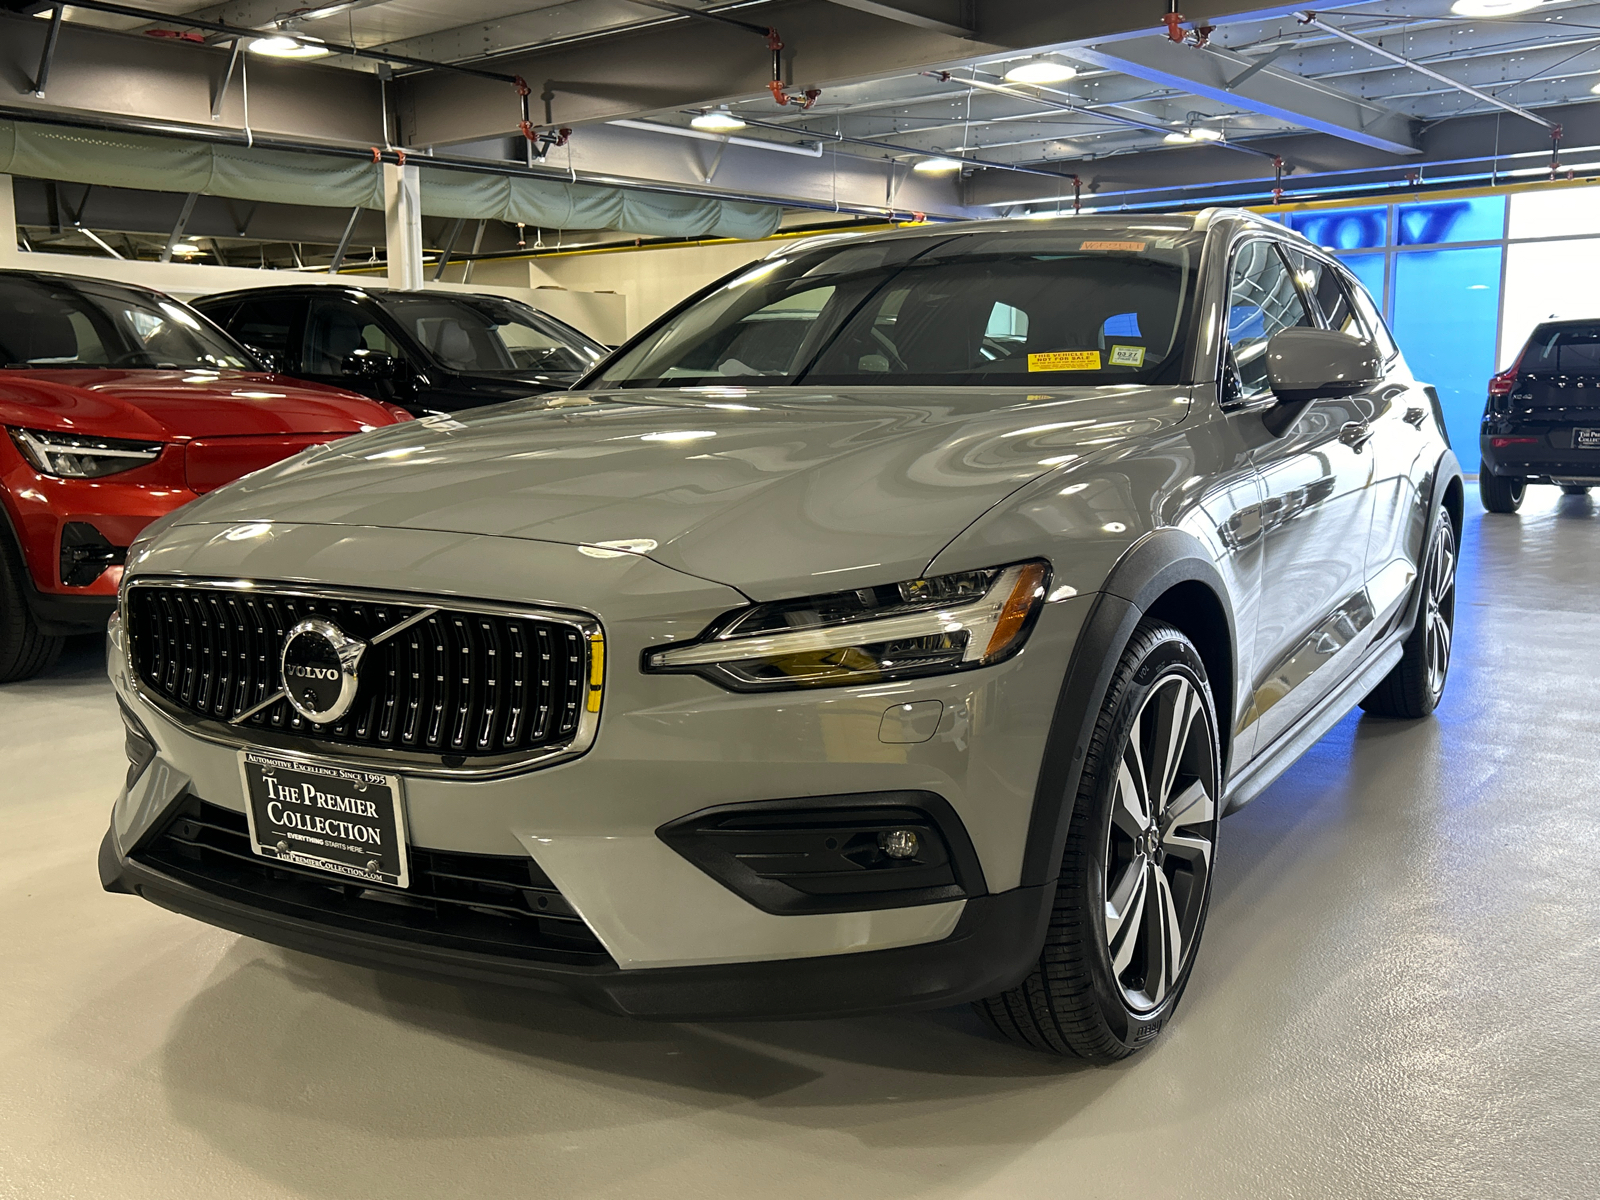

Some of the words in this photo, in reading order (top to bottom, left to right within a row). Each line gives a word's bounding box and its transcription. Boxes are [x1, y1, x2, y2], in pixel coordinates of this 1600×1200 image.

[284, 663, 339, 681] VOLVO
[247, 754, 292, 769] AUTOMOTIVE
[293, 762, 338, 777] EXCELLENCE
[339, 770, 362, 780] SINCE
[363, 774, 386, 785] 1995
[262, 776, 300, 804] THE
[301, 783, 379, 819] PREMIER
[267, 802, 381, 845] COLLECTION
[286, 832, 324, 846] EVERYTHING
[324, 839, 346, 850] STARTS
